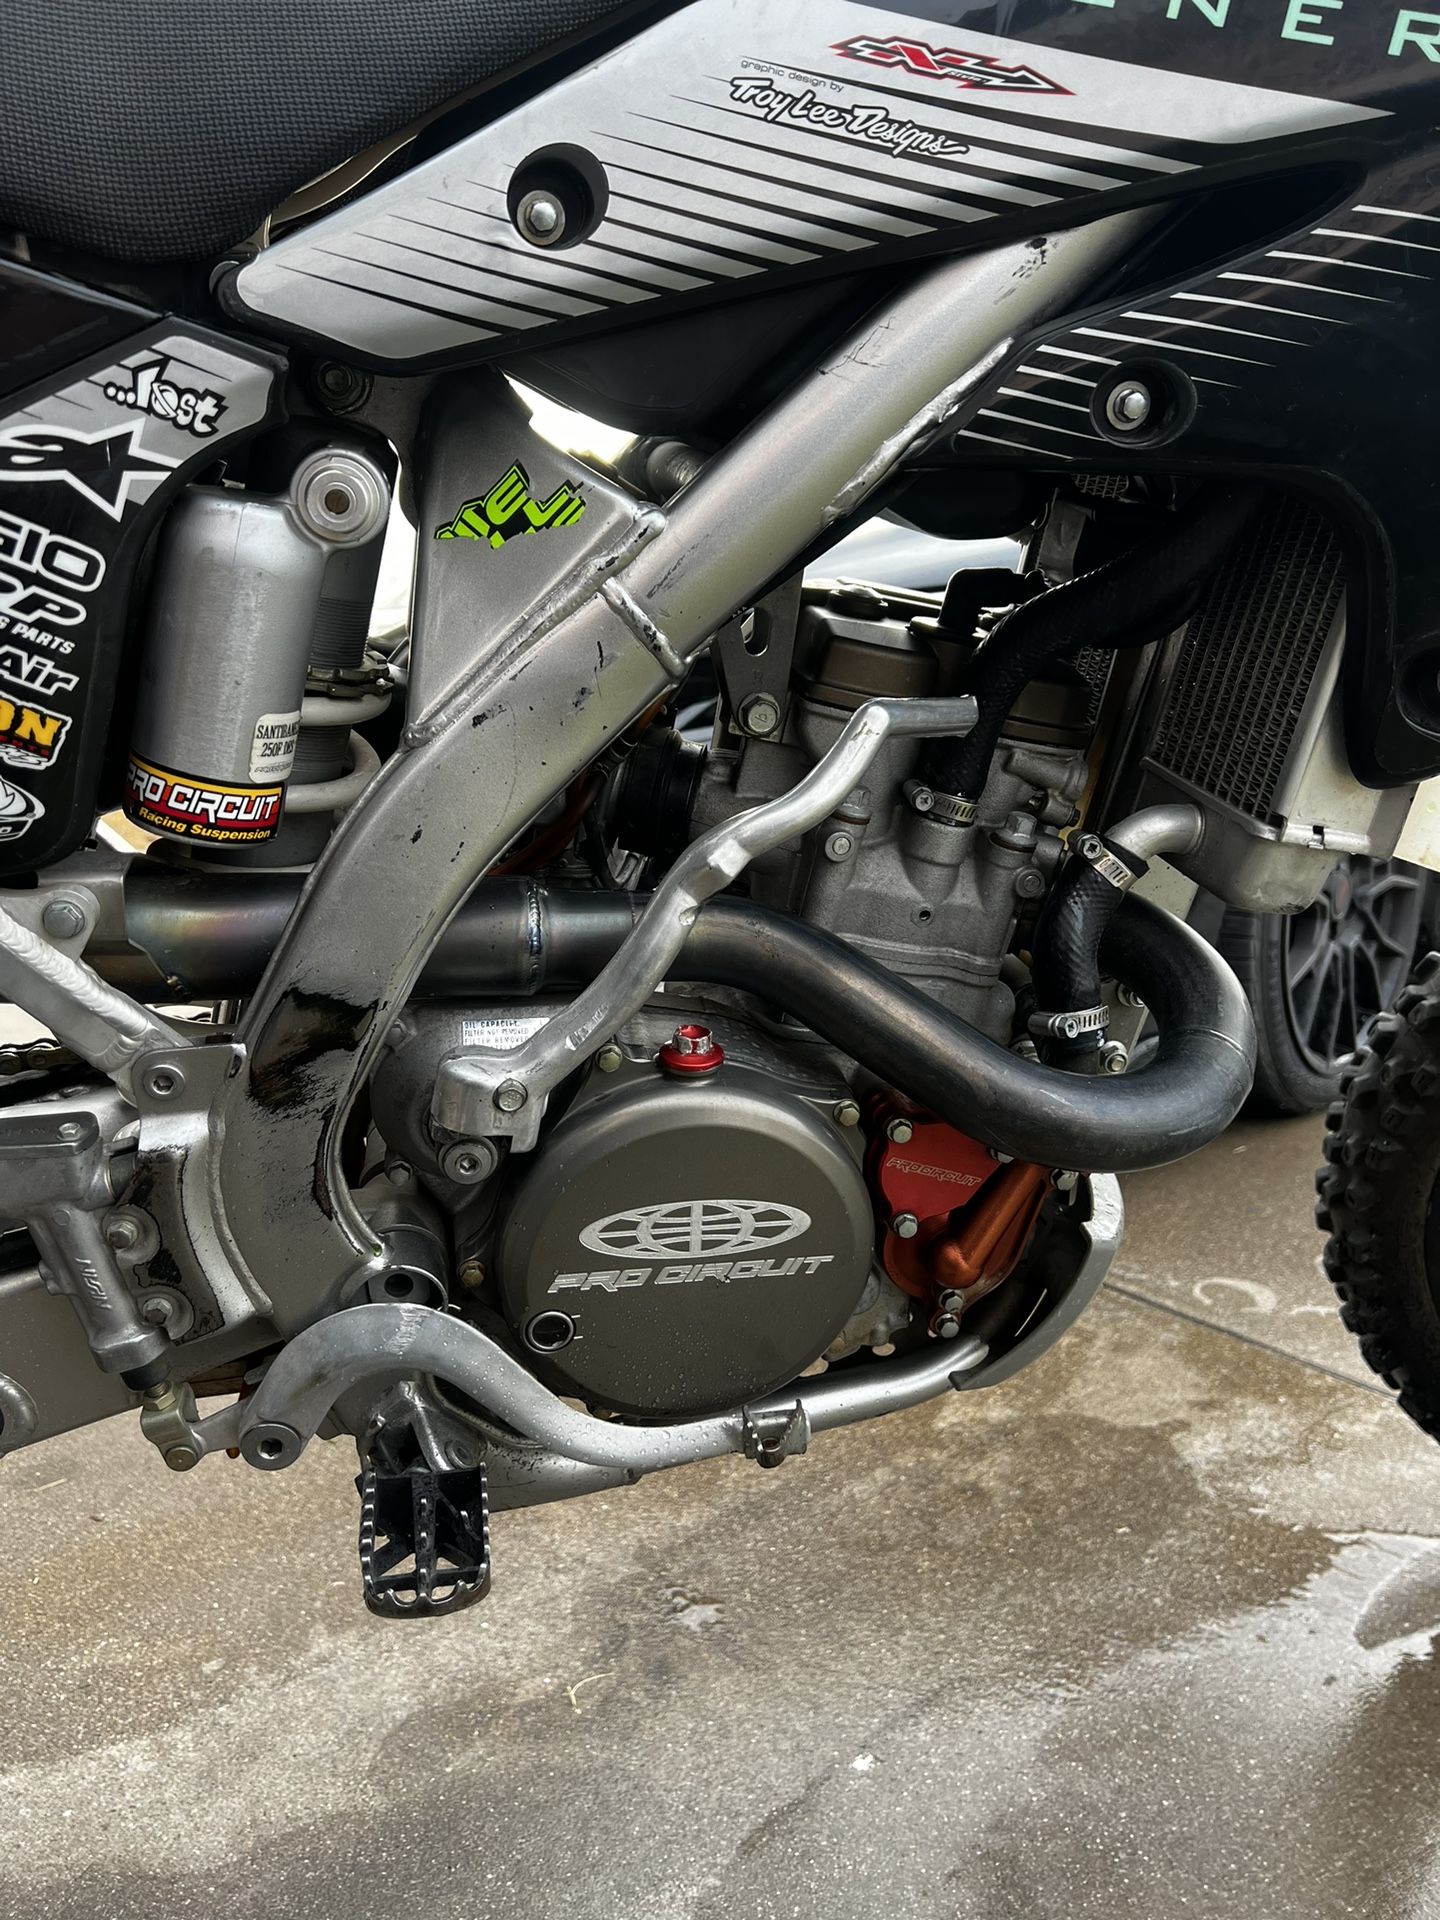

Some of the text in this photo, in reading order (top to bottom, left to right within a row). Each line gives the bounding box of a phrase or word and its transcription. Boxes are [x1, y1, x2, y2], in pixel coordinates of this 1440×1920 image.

[1070, 0, 1440, 62] NER
[741, 60, 844, 94] graphic design by
[730, 78, 969, 157] Troy Lee Designs
[11, 622, 76, 654] PARTS
[127, 762, 278, 823] PRO CIRCUIT
[139, 806, 270, 840] Racing Suspension
[548, 1254, 835, 1293] PRO CIRCUIT
